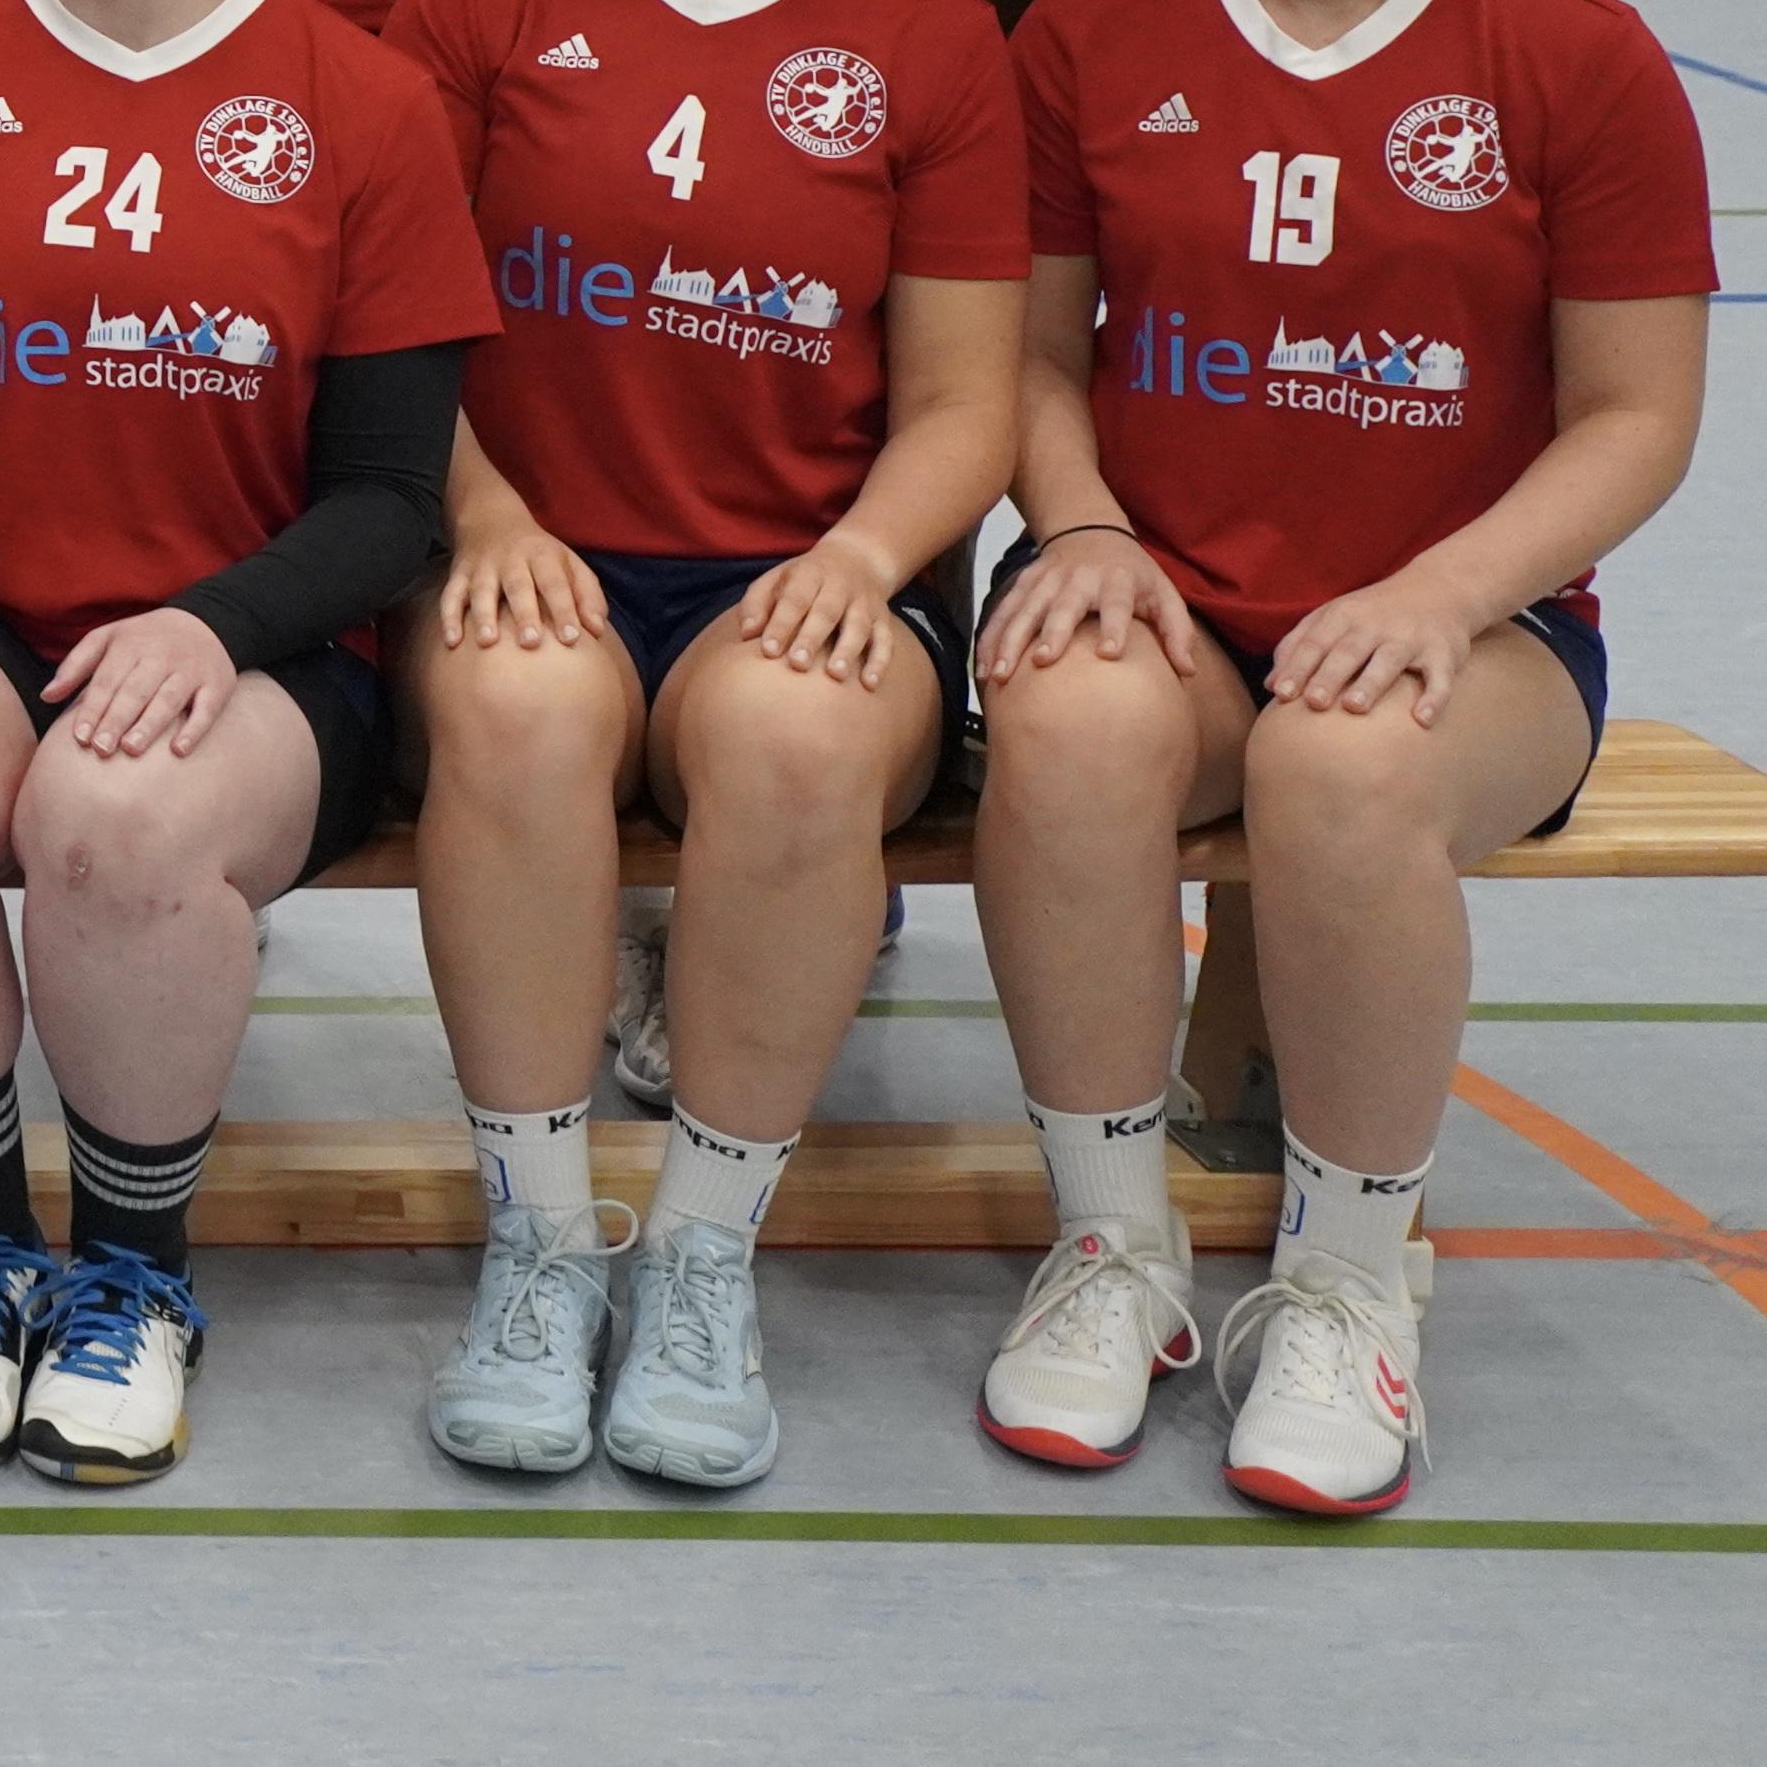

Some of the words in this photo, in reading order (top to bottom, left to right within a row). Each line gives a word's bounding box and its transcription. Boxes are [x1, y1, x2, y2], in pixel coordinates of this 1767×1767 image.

[538, 54, 599, 69] adidas
[776, 51, 849, 82] DINKLAGE
[771, 83, 786, 102] TV
[206, 100, 277, 132] DINKLAGE
[1138, 119, 1199, 133] adidas
[1395, 99, 1472, 138] DINKLAGE
[200, 134, 215, 151] TV
[647, 95, 705, 200] 4
[785, 124, 857, 155] HANDBALL
[1390, 142, 1407, 158] TV
[44, 147, 162, 252] 24
[215, 171, 284, 200] HANDBALL
[1407, 180, 1491, 208] HANDBALL
[1243, 151, 1340, 265] 19
[502, 227, 634, 326] die
[646, 303, 834, 365] stadtpraxis
[86, 352, 262, 401] stadtpraxis
[1266, 376, 1462, 429] stadtpraxis
